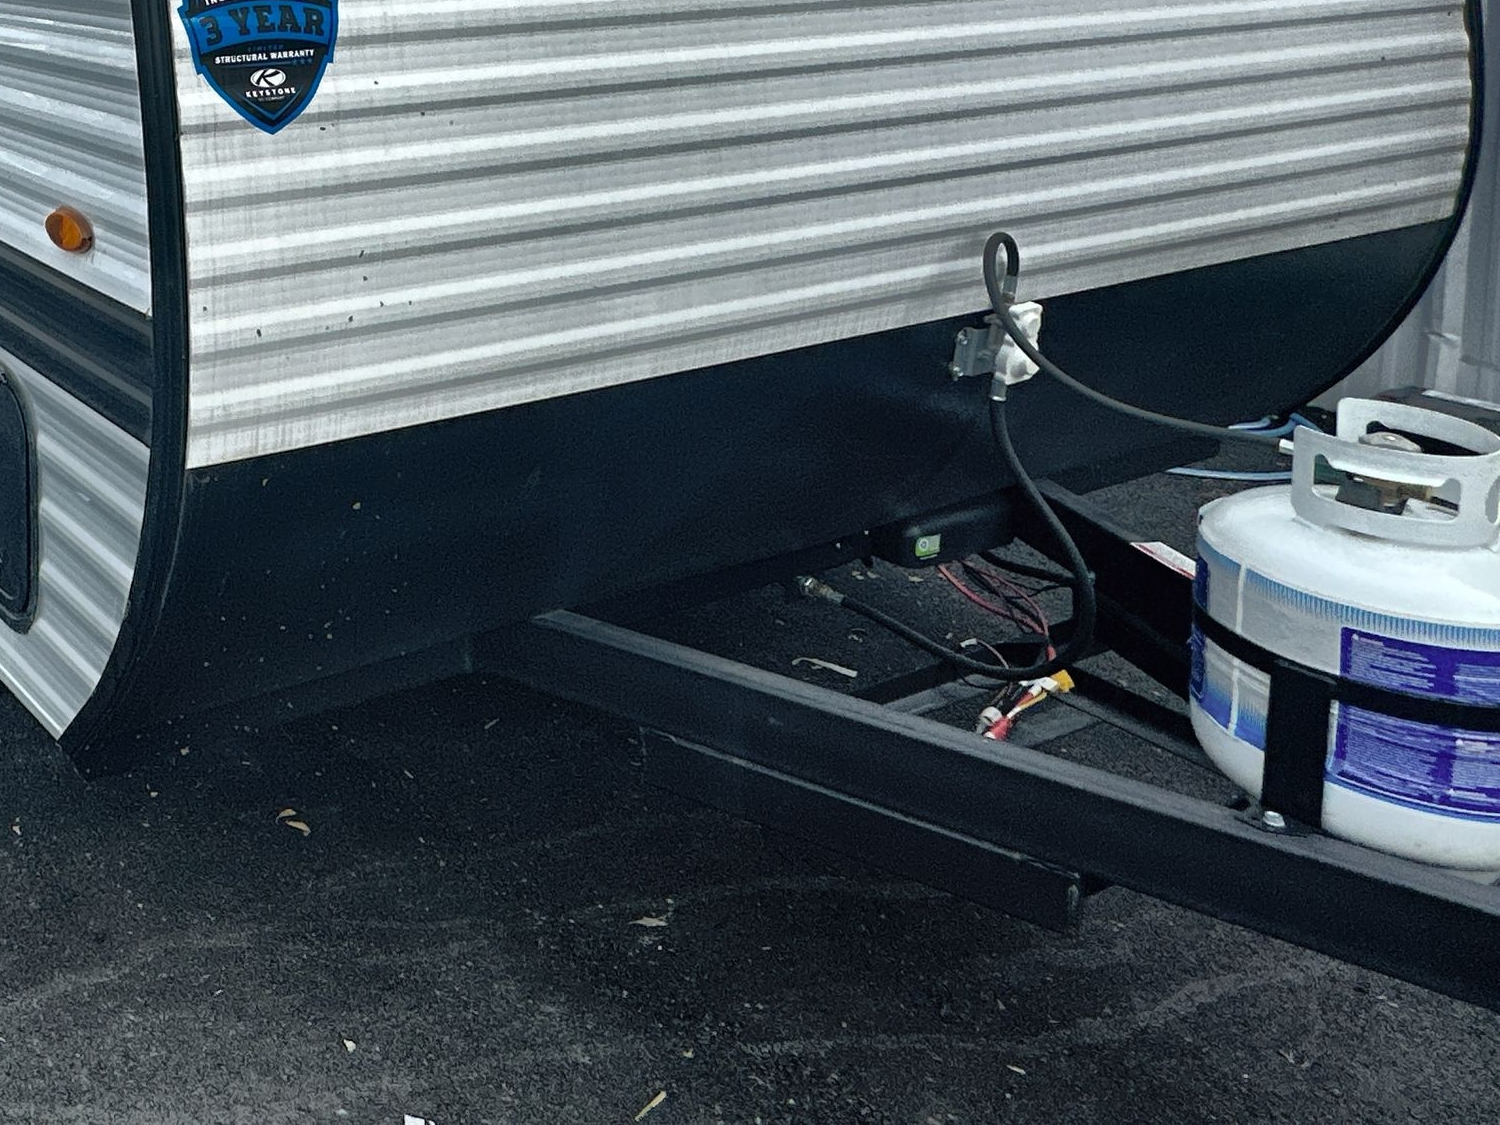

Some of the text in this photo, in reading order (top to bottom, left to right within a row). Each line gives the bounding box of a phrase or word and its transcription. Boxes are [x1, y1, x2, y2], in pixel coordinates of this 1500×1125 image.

[199, 5, 325, 46] 3 YEAR
[215, 49, 315, 65] STRUCTURAL WARRANTY
[245, 87, 296, 98] KEYSTONE
